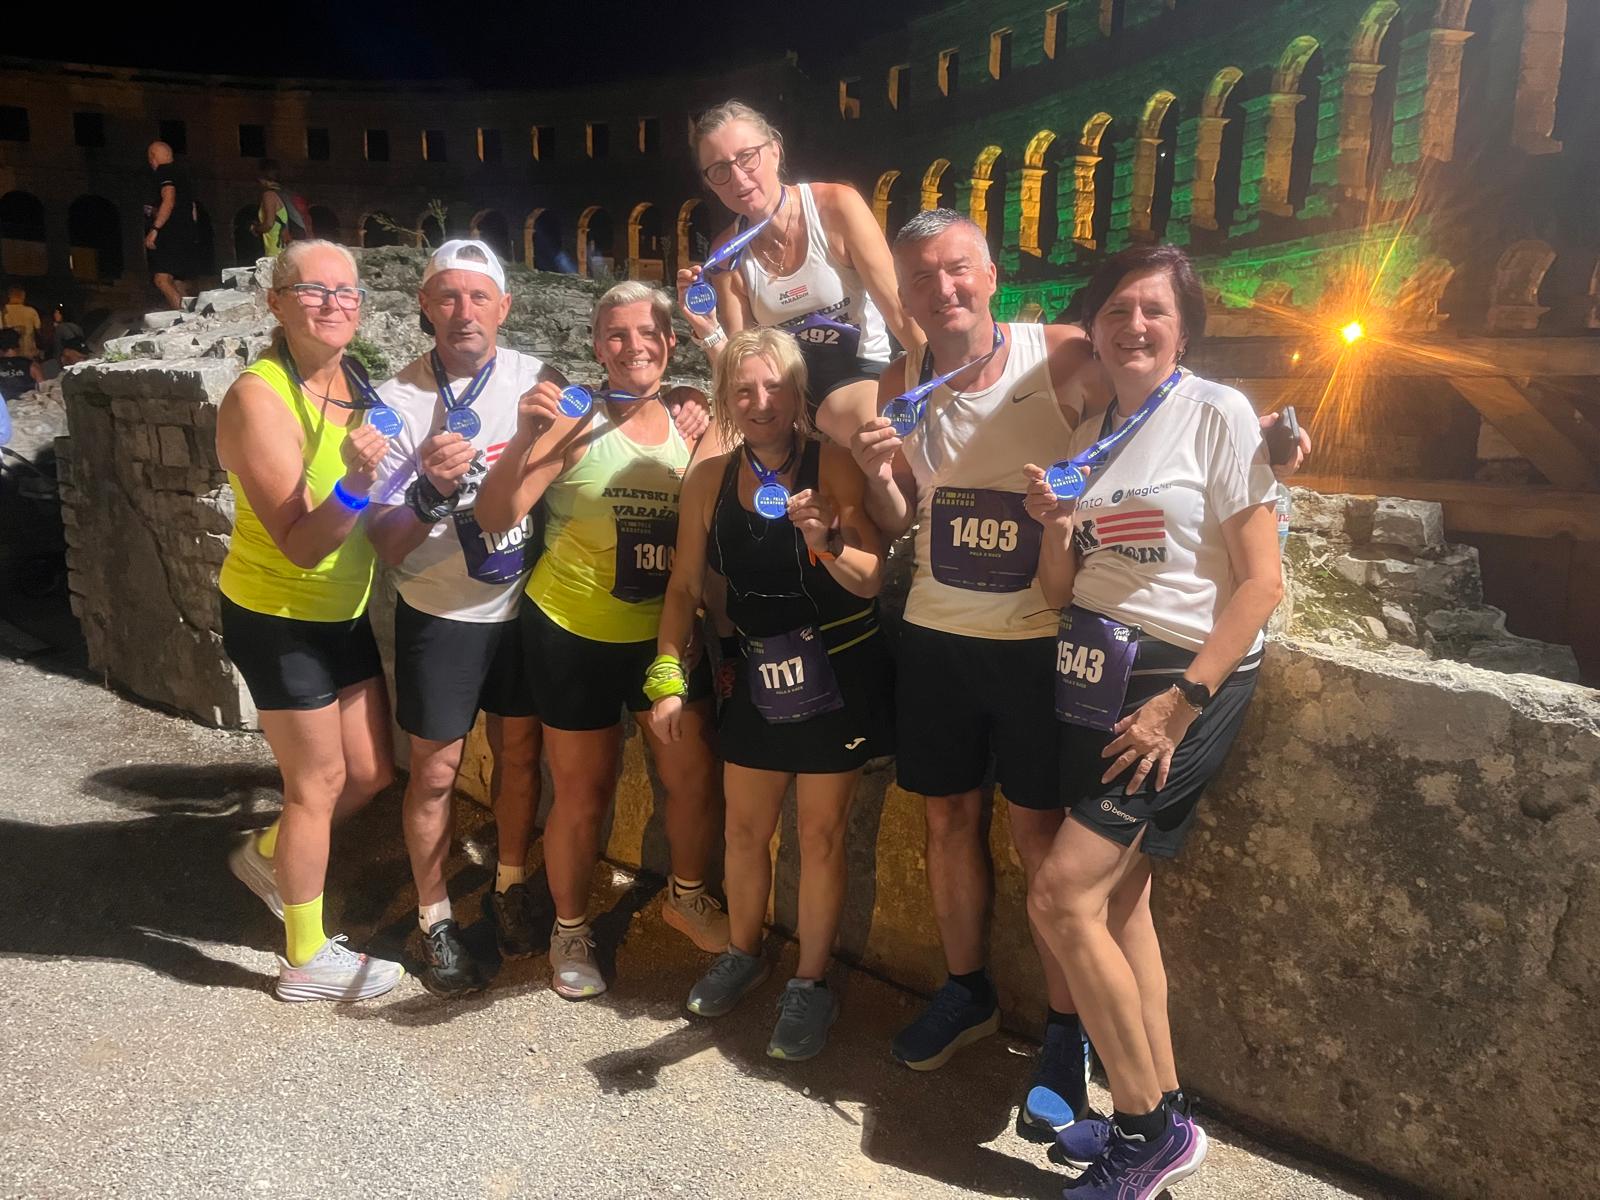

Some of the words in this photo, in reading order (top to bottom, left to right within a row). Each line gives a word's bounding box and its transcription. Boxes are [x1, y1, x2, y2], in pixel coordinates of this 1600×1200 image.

[602, 487, 669, 502] ATLETSKI
[950, 516, 1019, 552] 1493
[758, 656, 805, 689] 1717
[1056, 640, 1105, 684] 1543
